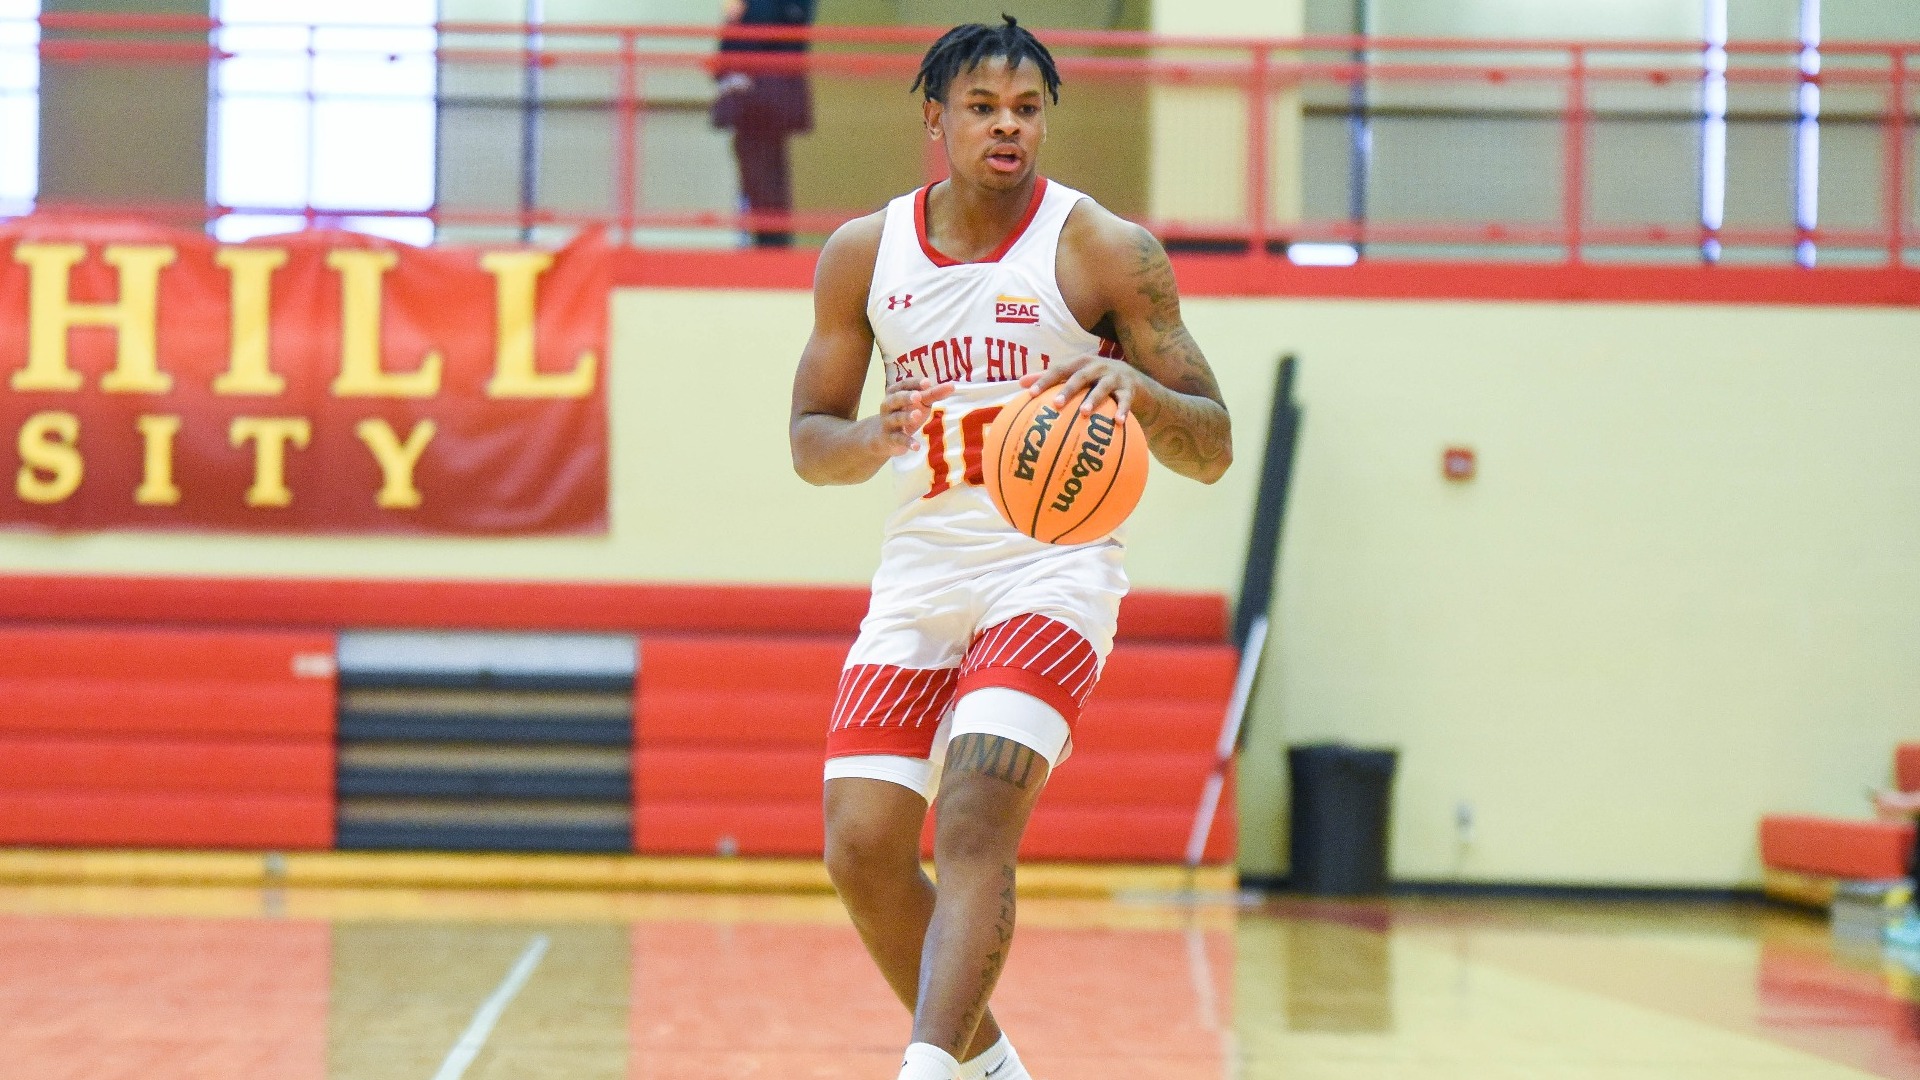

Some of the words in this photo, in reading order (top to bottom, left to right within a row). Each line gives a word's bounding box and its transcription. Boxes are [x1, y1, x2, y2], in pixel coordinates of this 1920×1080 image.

[11, 243, 597, 397] HILL
[995, 302, 1040, 317] PSAC
[15, 411, 437, 508] SITY
[1013, 405, 1060, 481] NCAA
[1050, 413, 1116, 513] Wilson
